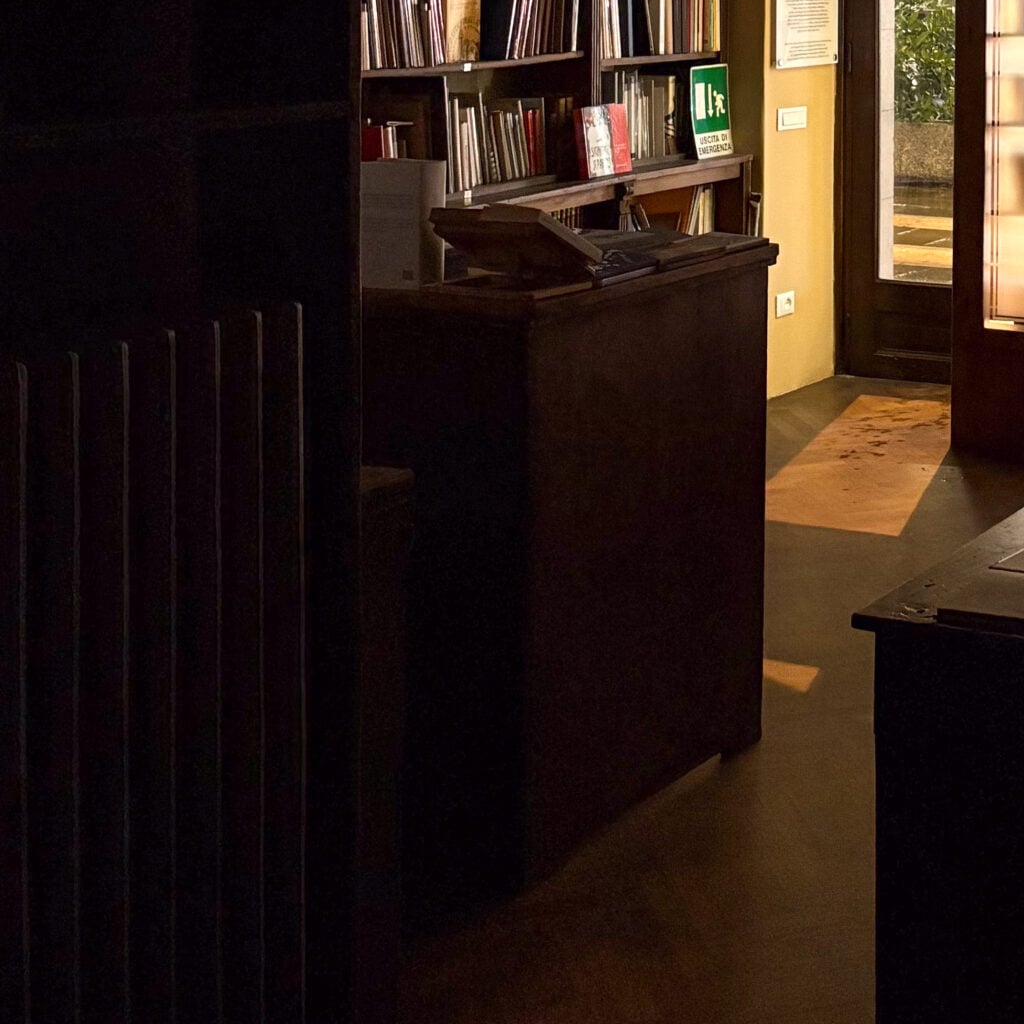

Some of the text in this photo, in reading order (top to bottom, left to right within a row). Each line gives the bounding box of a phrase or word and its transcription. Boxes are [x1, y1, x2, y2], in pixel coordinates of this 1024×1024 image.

[699, 133, 728, 145] USCITA DI
[698, 142, 732, 153] EMERGENZA
